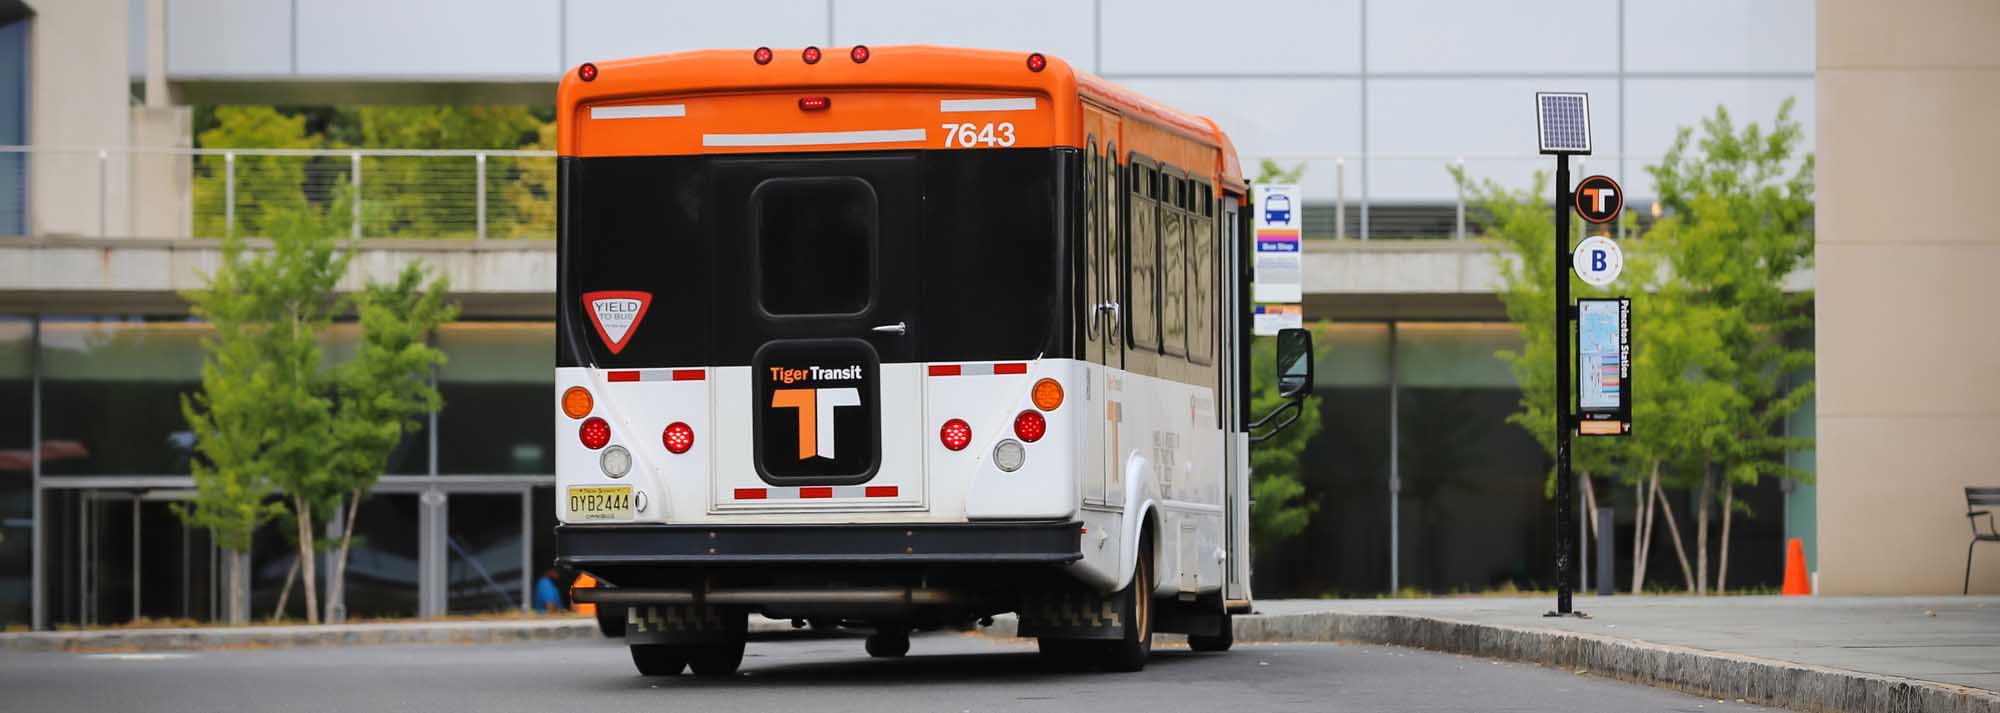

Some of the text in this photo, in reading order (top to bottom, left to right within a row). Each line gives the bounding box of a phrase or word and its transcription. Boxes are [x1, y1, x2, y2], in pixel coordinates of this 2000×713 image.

[942, 122, 1016, 148] 7643
[1591, 249, 1608, 271] B
[594, 301, 638, 312] YIELD
[1620, 299, 1630, 378] Princeton Station
[770, 365, 862, 384] Tiger Transit
